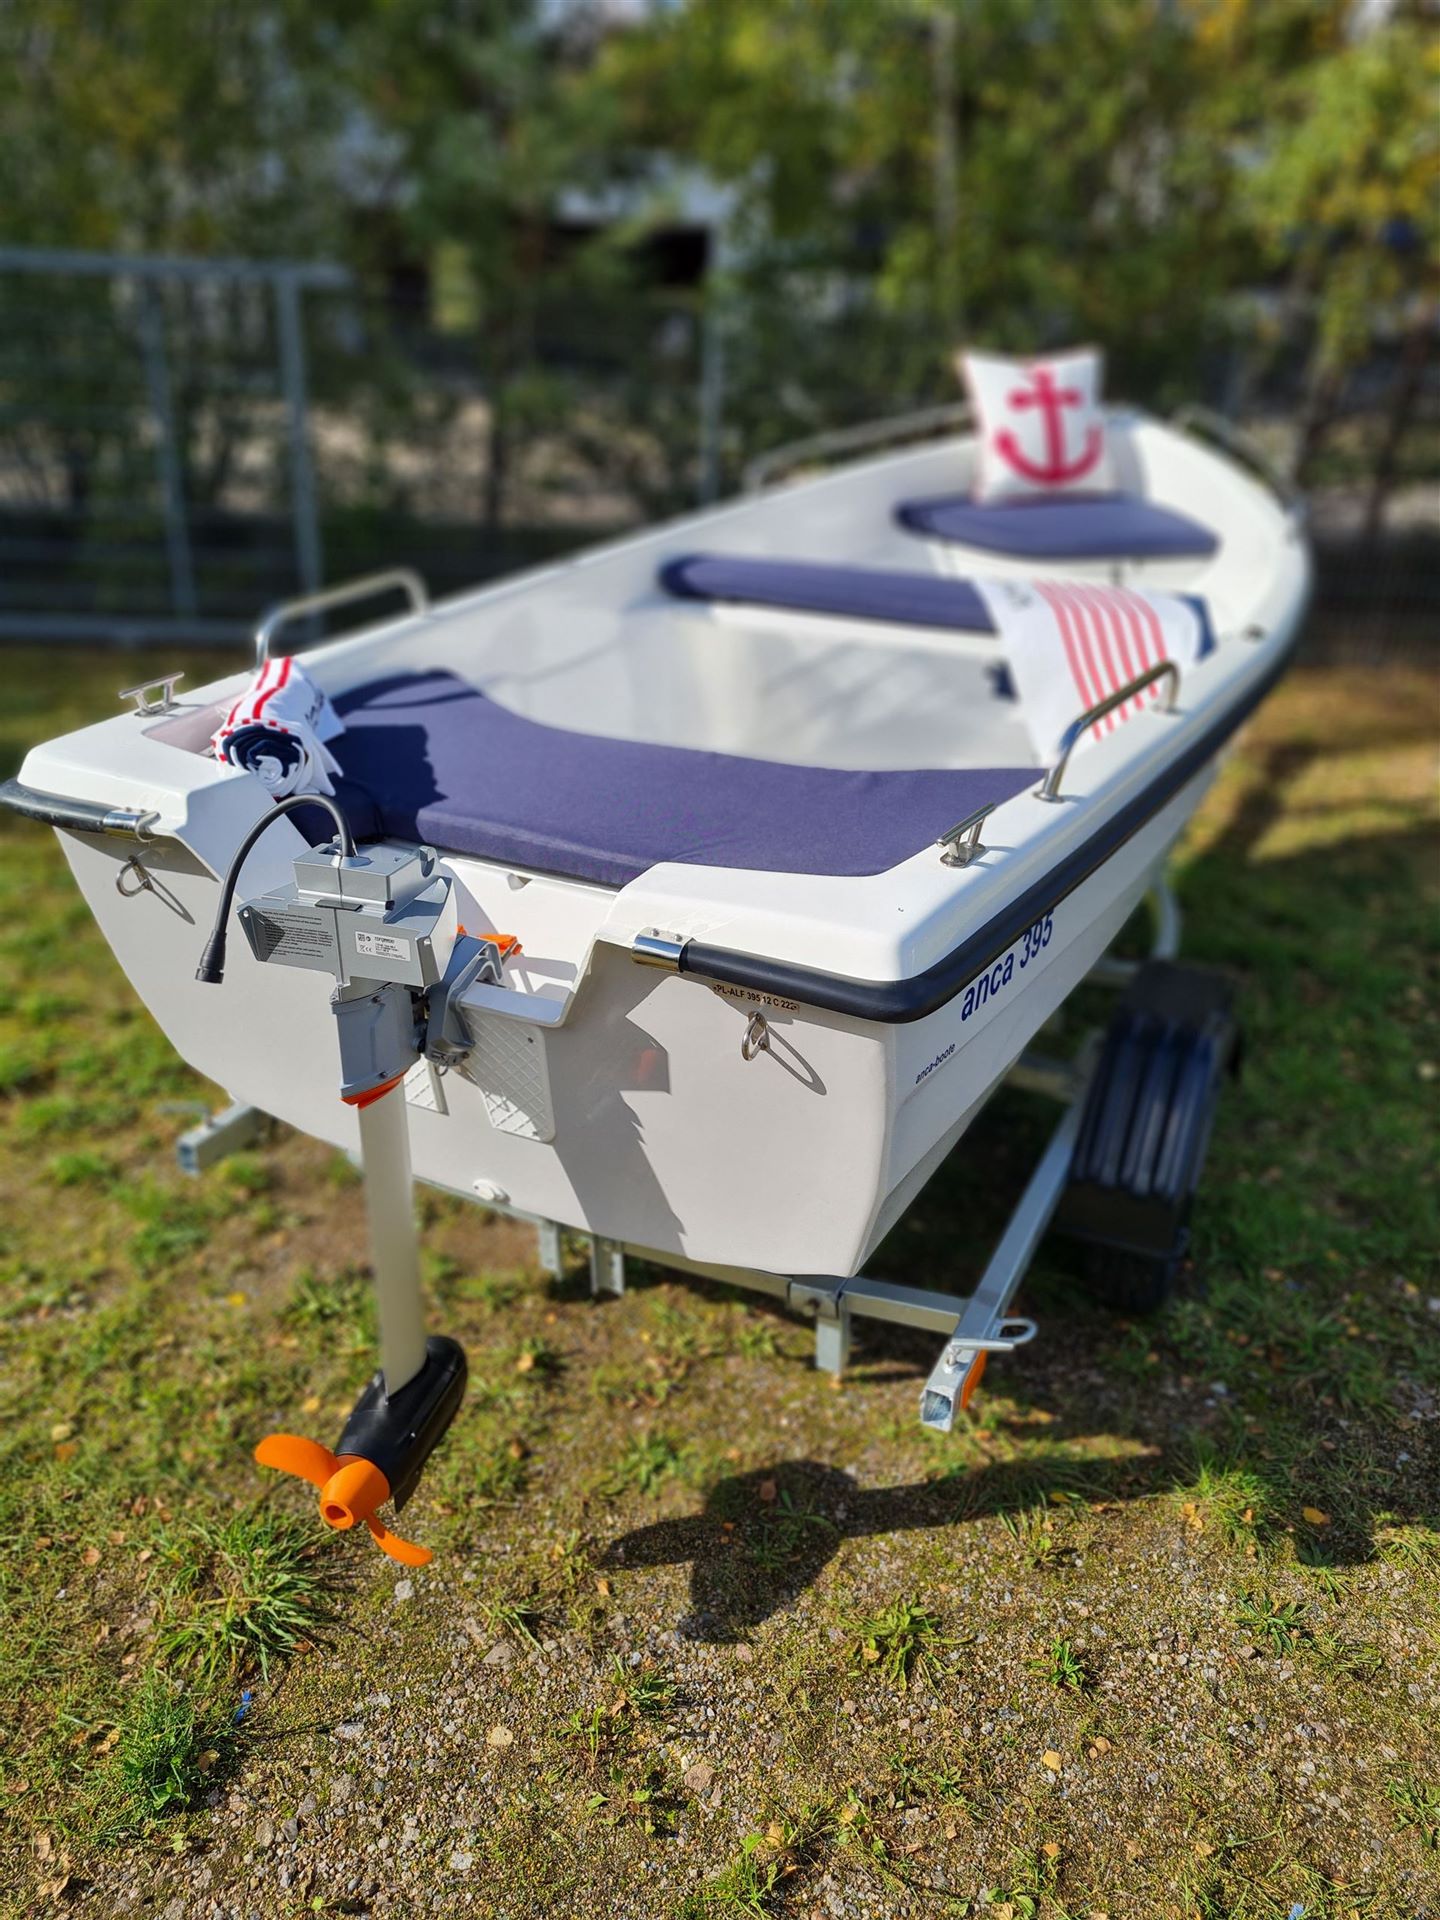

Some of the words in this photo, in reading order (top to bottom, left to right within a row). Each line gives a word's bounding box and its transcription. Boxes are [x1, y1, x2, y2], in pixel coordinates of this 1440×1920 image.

[961, 952, 1014, 1021] anca
[1020, 908, 1055, 968] 395
[915, 1043, 956, 1084] anca-boote
